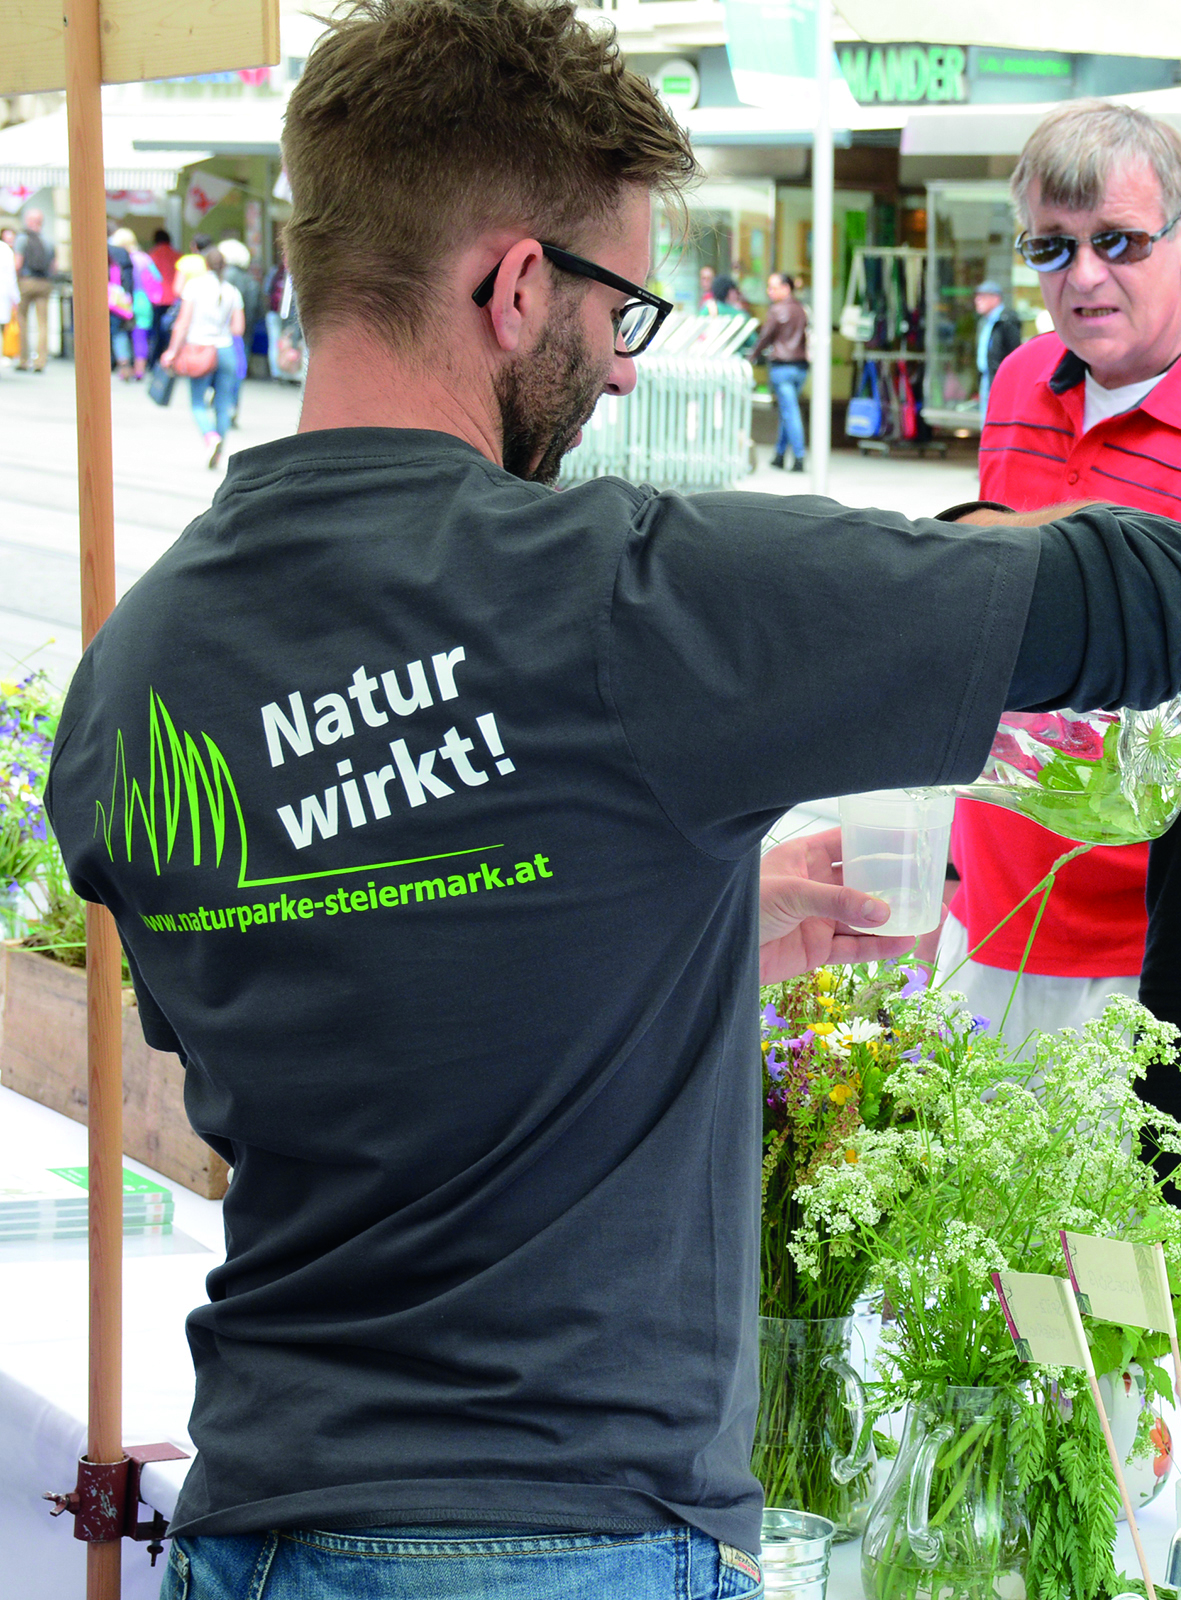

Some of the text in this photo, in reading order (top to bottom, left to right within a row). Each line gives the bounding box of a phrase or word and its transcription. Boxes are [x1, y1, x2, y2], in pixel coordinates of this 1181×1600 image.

[261, 646, 466, 768] Natur
[277, 712, 516, 850] wirkt!
[138, 853, 553, 933] ww.naturparke-steiermark.at
